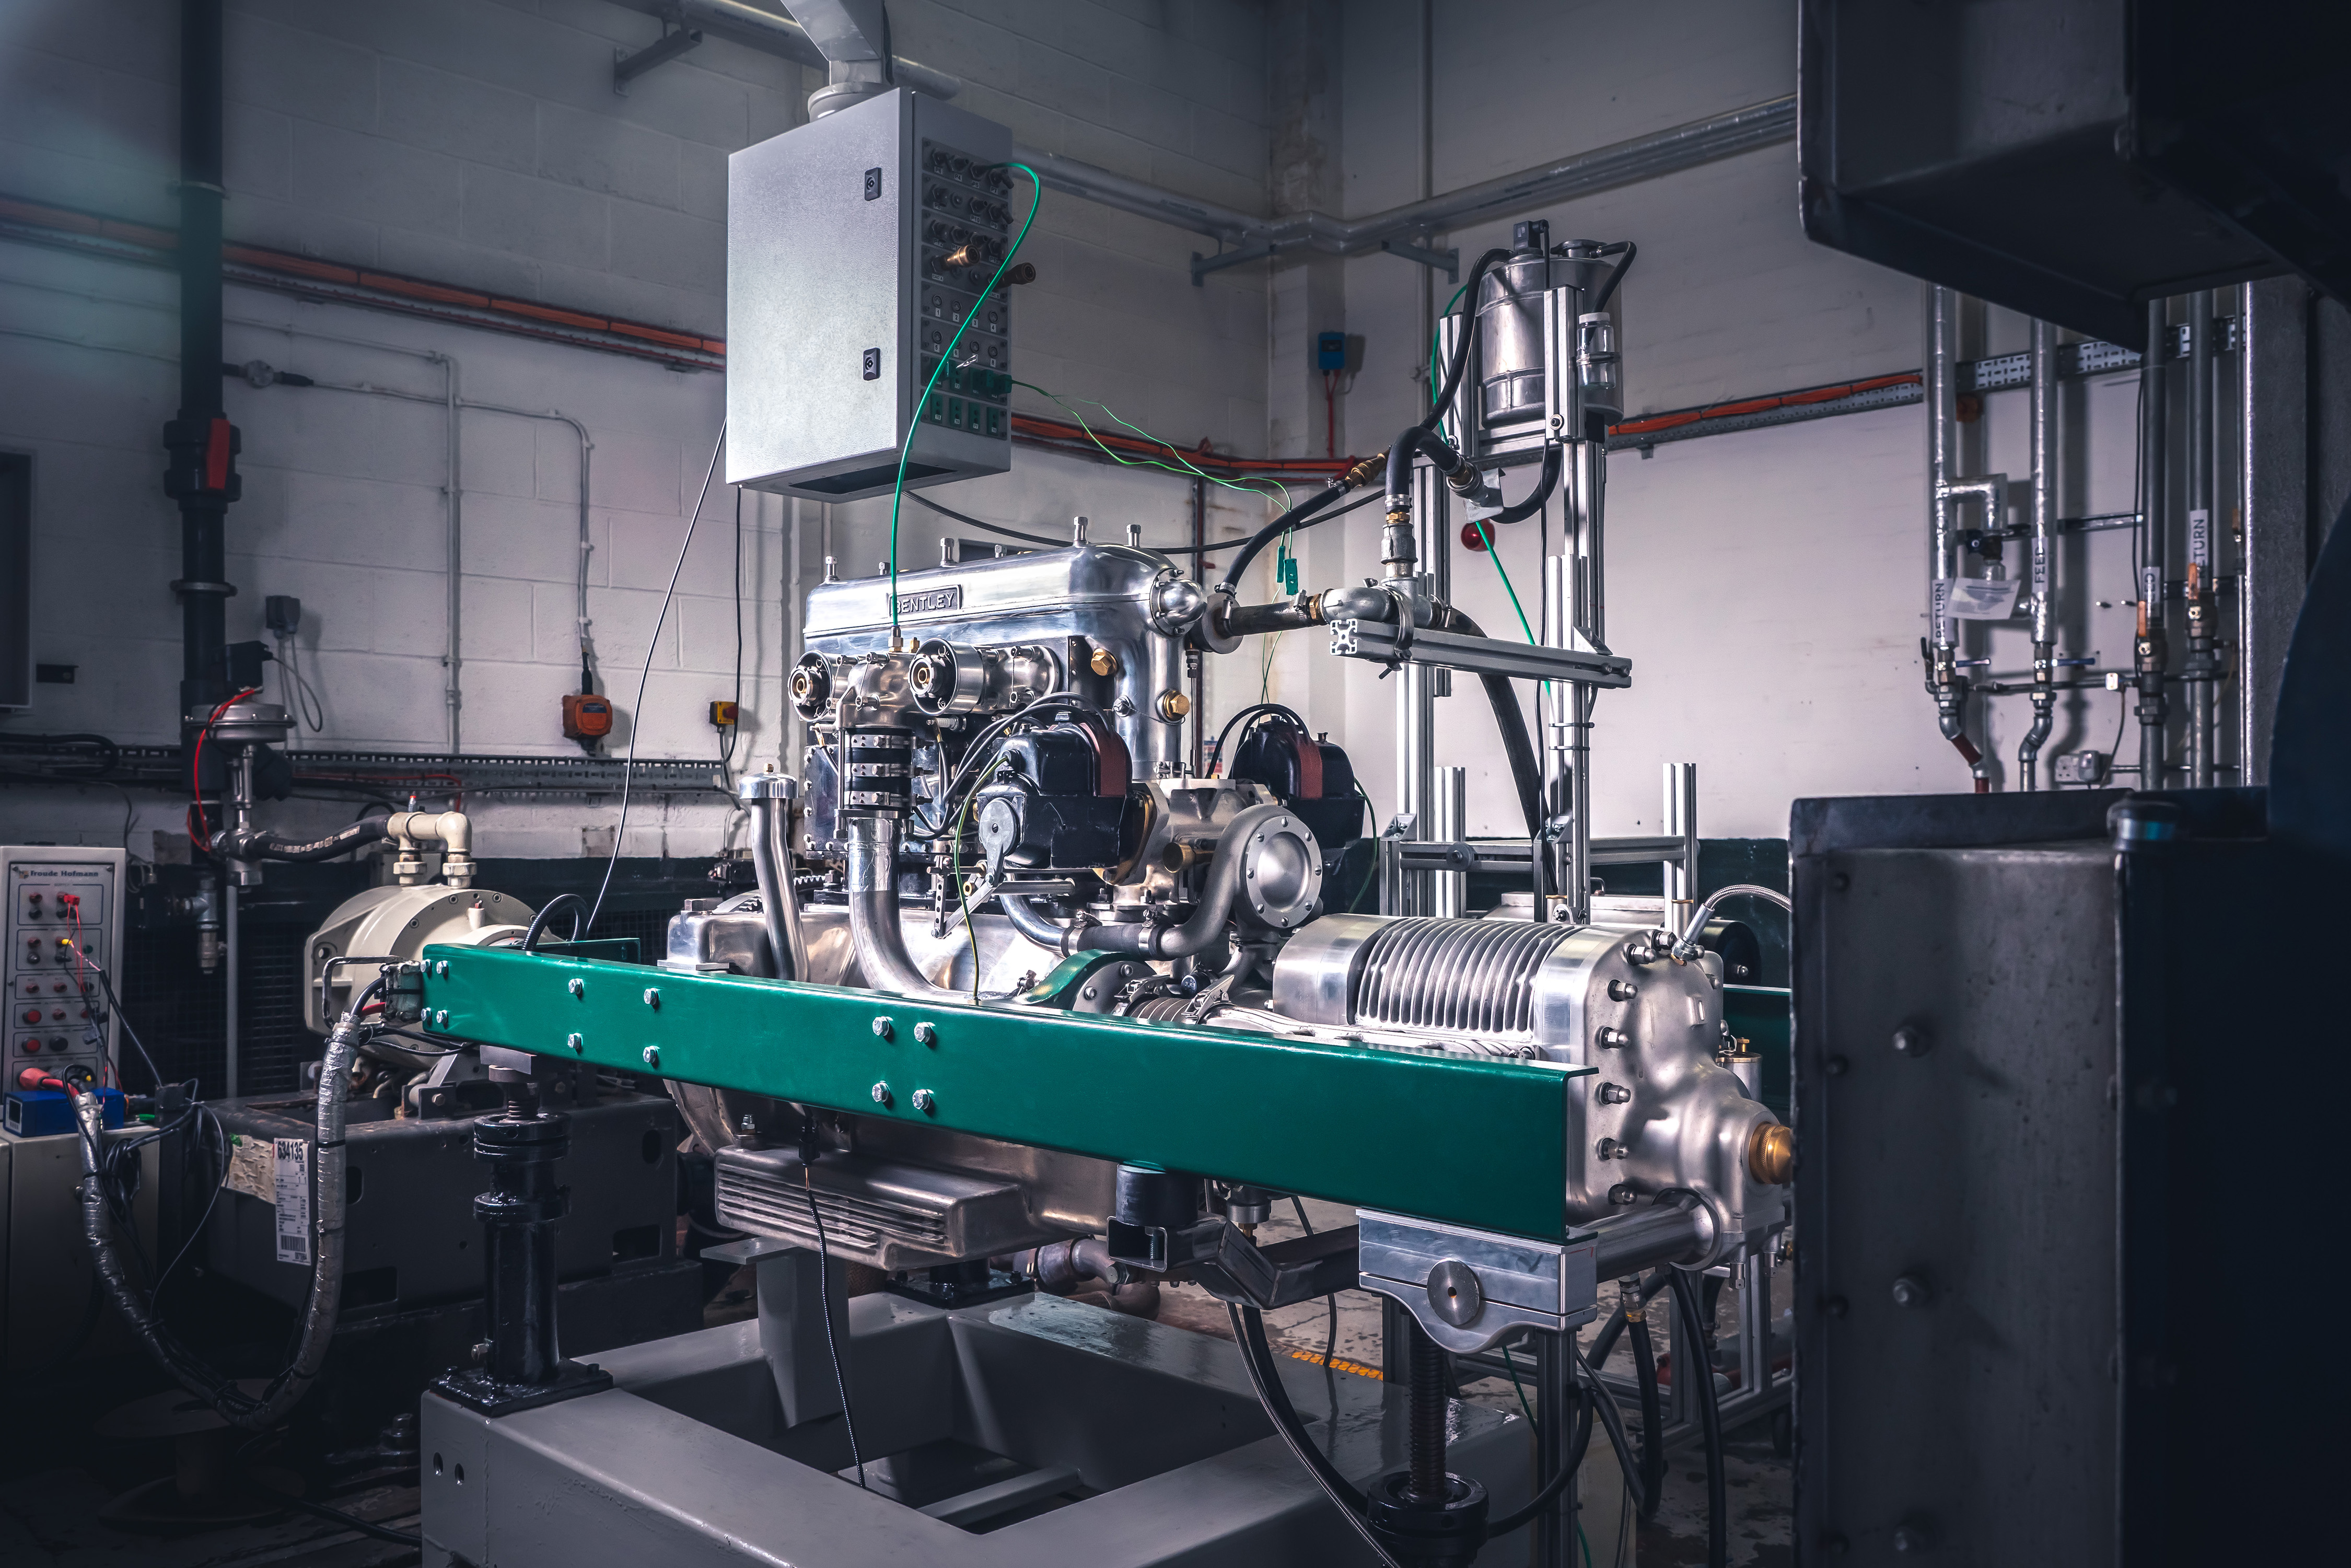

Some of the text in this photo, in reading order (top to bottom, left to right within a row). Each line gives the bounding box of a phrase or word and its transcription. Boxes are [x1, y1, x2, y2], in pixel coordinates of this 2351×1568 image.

[2034, 547, 2045, 583] FEED
[2194, 519, 2205, 578] RTURN
[895, 593, 955, 614] BENTLEY
[1935, 583, 1945, 638] RETURN
[277, 1141, 304, 1160] 634135
